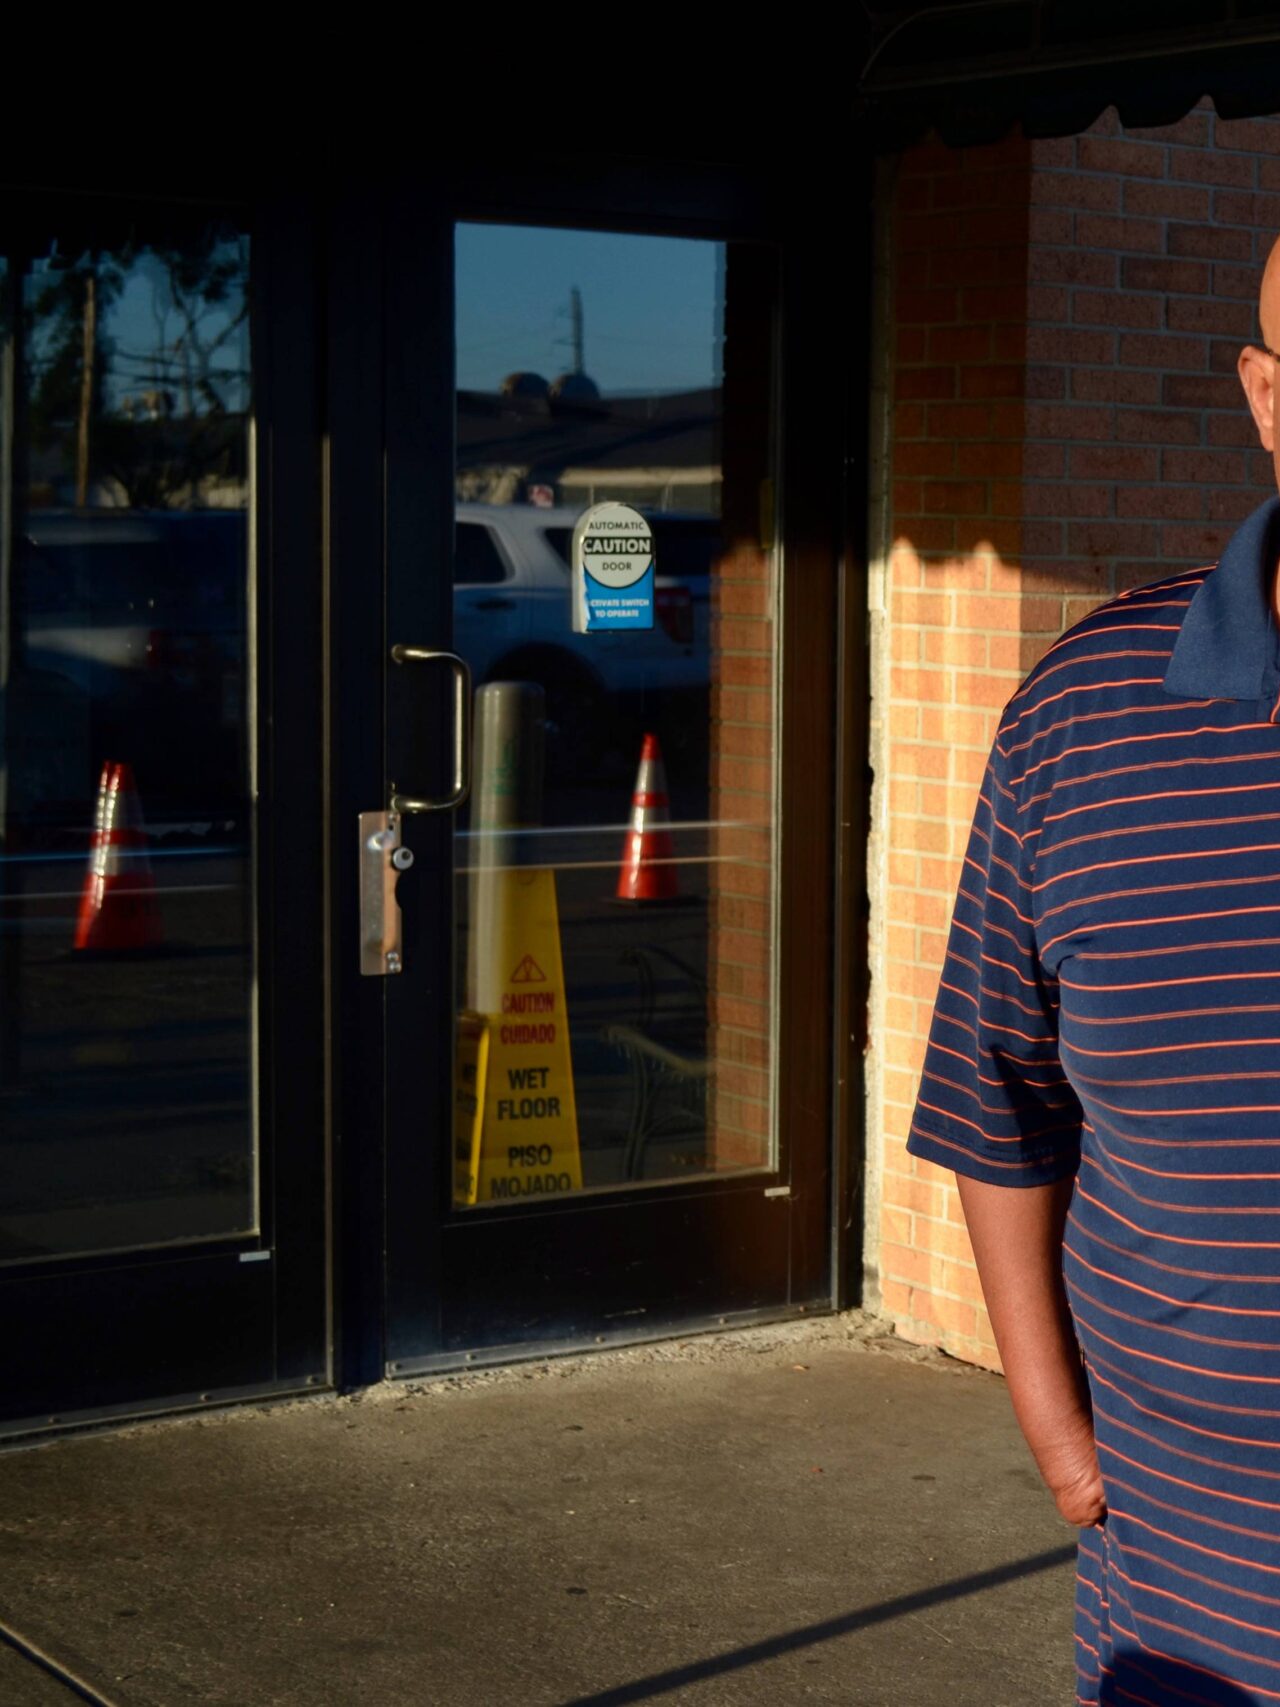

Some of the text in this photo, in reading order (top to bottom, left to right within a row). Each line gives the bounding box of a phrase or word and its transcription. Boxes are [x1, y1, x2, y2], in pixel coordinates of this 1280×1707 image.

[588, 521, 644, 530] AUTOMATIC
[583, 538, 651, 553] CAUTION
[602, 562, 632, 571] DOOR
[595, 609, 606, 618] TO
[502, 992, 555, 1014] CAUTION
[501, 1024, 556, 1045] CUIDADO
[507, 1067, 549, 1090] WET
[497, 1096, 561, 1120] FLOOR
[507, 1143, 552, 1168] PISO
[490, 1172, 572, 1199] MOJADO
